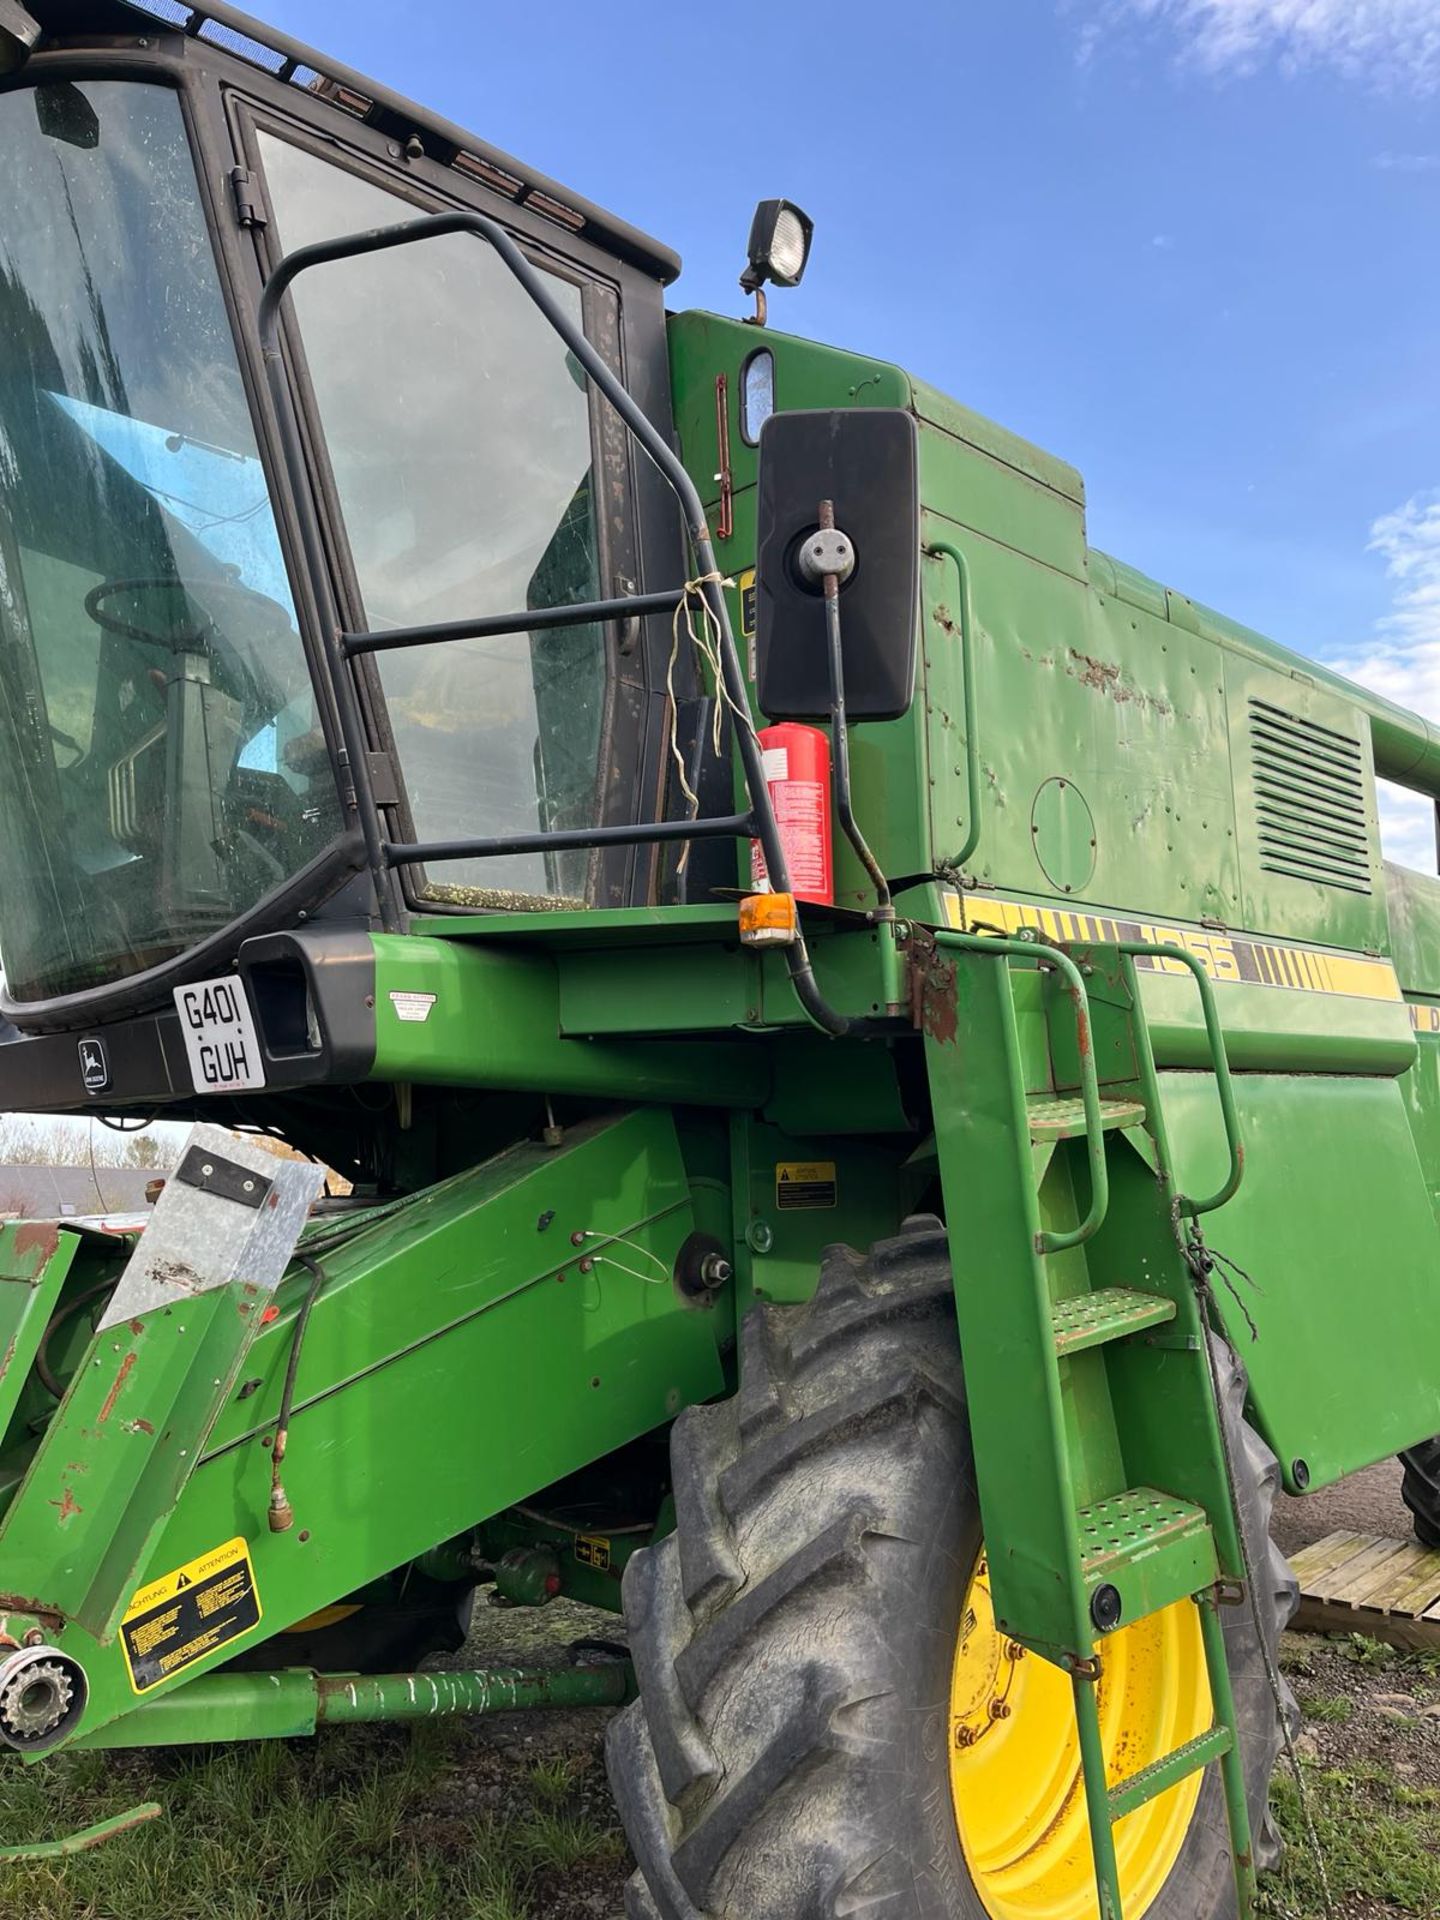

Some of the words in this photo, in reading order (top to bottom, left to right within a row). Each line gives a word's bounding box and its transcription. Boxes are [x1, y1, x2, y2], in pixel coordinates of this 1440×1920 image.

[184, 984, 241, 1029] G401
[200, 1041, 249, 1084] GUH
[198, 1547, 240, 1574] ATTENTION
